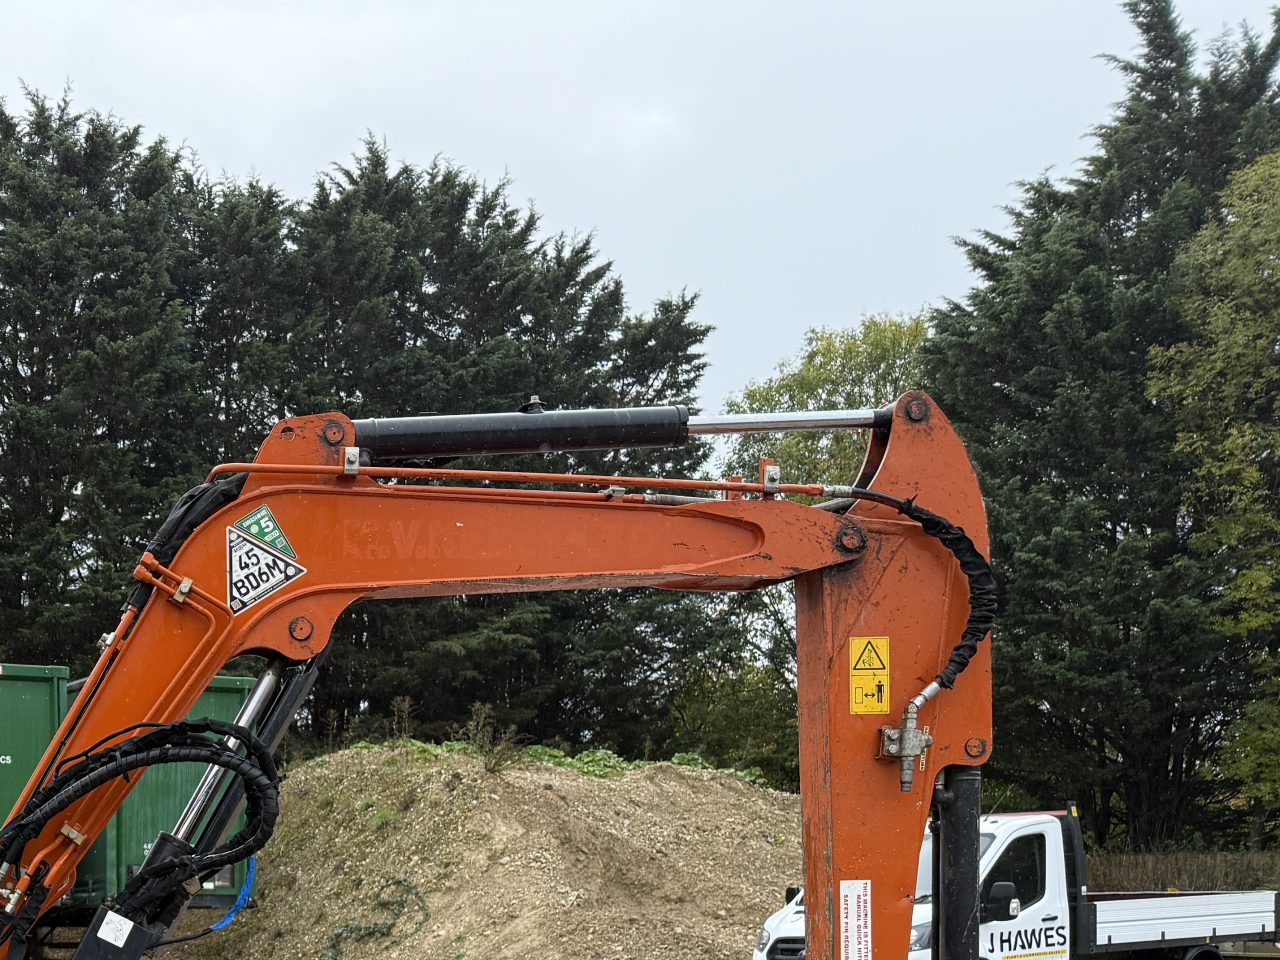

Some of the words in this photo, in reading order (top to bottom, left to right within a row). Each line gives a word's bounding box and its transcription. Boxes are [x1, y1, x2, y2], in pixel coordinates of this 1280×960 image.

[259, 516, 274, 533] 5
[238, 547, 261, 571] 45
[233, 558, 285, 598] BD6M
[863, 931, 869, 939] IS
[988, 932, 995, 954] J
[1000, 926, 1067, 953] HAWES
